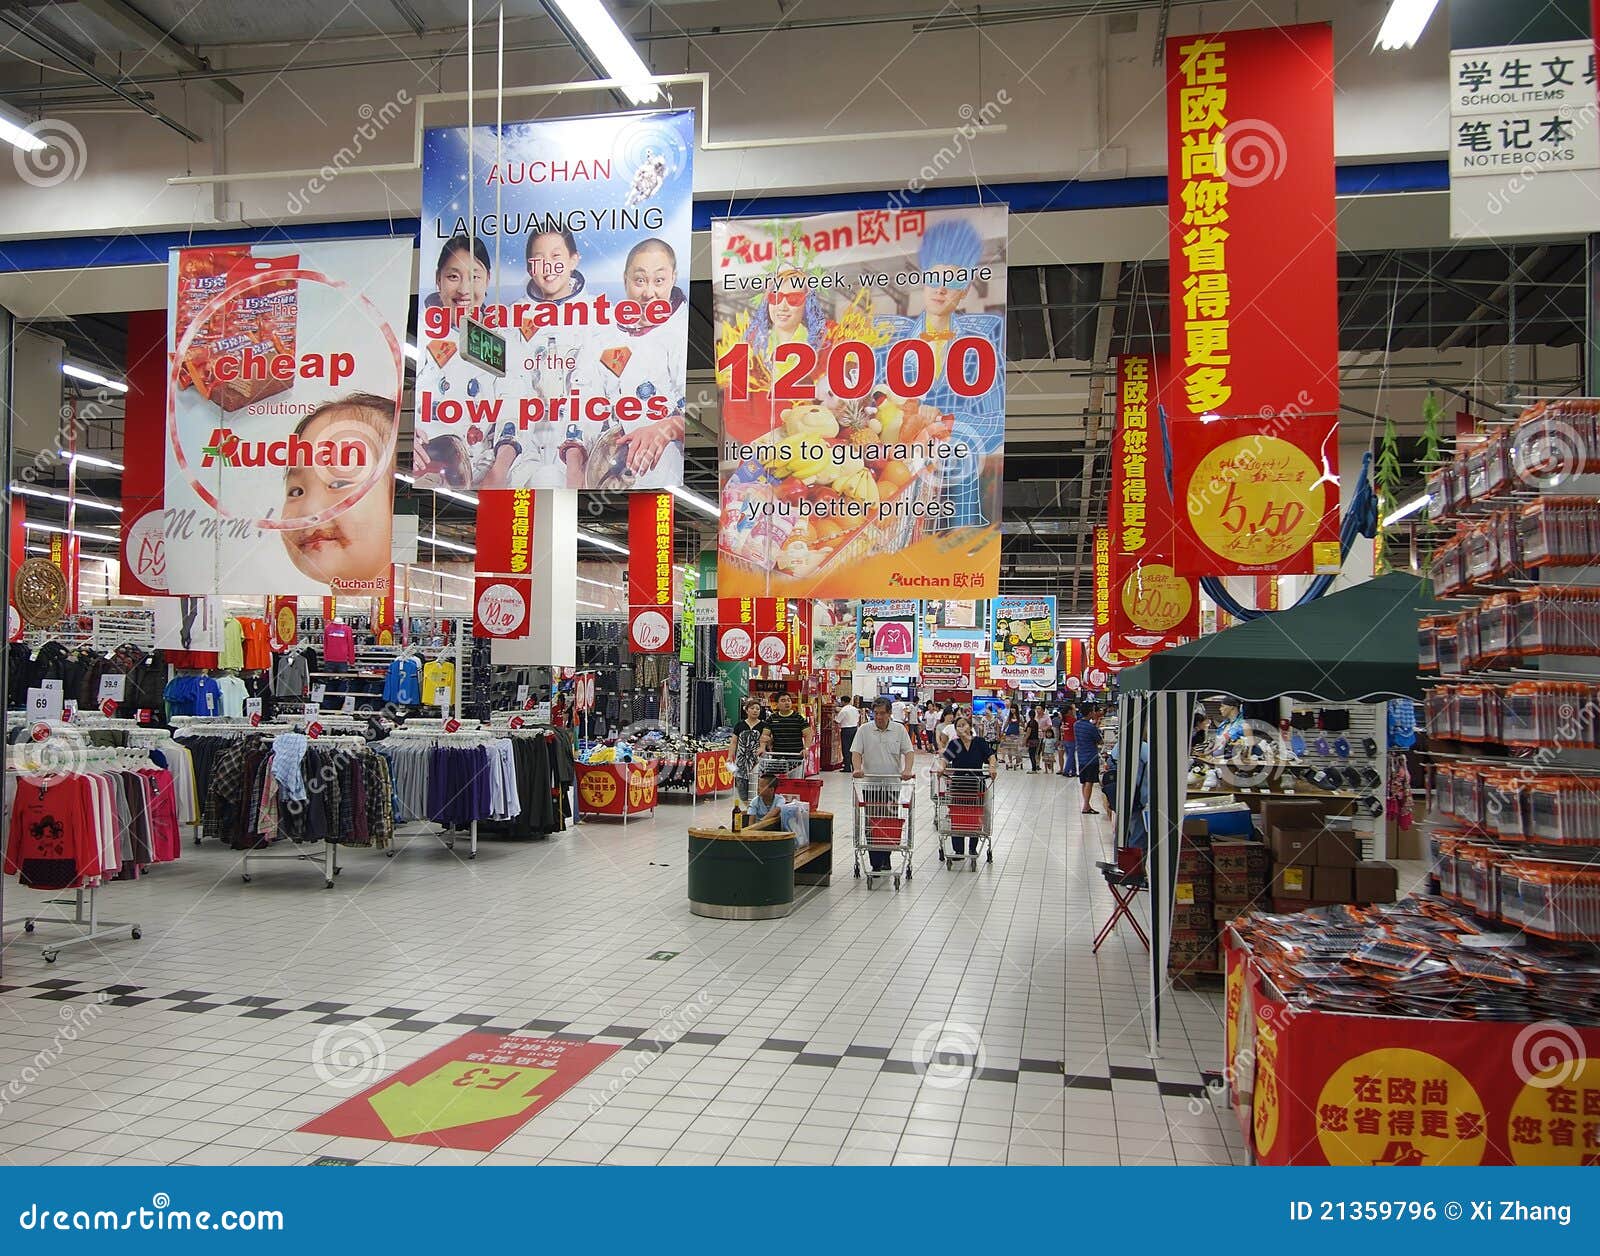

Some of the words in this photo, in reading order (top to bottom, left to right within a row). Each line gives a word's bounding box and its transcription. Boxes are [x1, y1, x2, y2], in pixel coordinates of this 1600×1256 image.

[1461, 92, 1518, 106] SCHOOL
[1522, 89, 1565, 102] ITEMS
[1458, 115, 1574, 152] 笔记本
[486, 158, 611, 186] AUCHAN
[1463, 149, 1575, 167] NOTEBOOKS
[436, 207, 664, 239] LAIGUANGYING
[1179, 40, 1232, 416] 在欧尚您省得更多
[721, 225, 852, 267] Auchan
[528, 257, 564, 275] The
[723, 272, 784, 293] Every
[789, 273, 852, 291] week,
[860, 271, 888, 287] we
[895, 266, 992, 289] compare
[424, 293, 673, 339] guarantee
[214, 347, 355, 386] cheap
[523, 353, 543, 370] of
[546, 353, 576, 370] the
[718, 335, 997, 401] 12000
[247, 400, 316, 415] solutions
[421, 390, 503, 424] low
[518, 389, 670, 431] prices
[201, 428, 367, 468] Auchan
[725, 441, 792, 460] items
[800, 441, 824, 460] to
[832, 440, 969, 465] guarantee
[1122, 356, 1148, 552] 在欧尚您省得更多
[748, 499, 791, 520] you
[799, 497, 871, 516] better
[879, 497, 956, 519] prices
[656, 494, 670, 605] 在欧尚您省得更多
[330, 577, 375, 589] Auchan
[888, 573, 950, 588] Auchan
[953, 572, 985, 588] 欧尚
[35, 698, 47, 709] 69
[453, 1067, 522, 1090] F3
[1353, 1074, 1449, 1106] 在欧尚
[1319, 1103, 1485, 1141] 您省得更多
